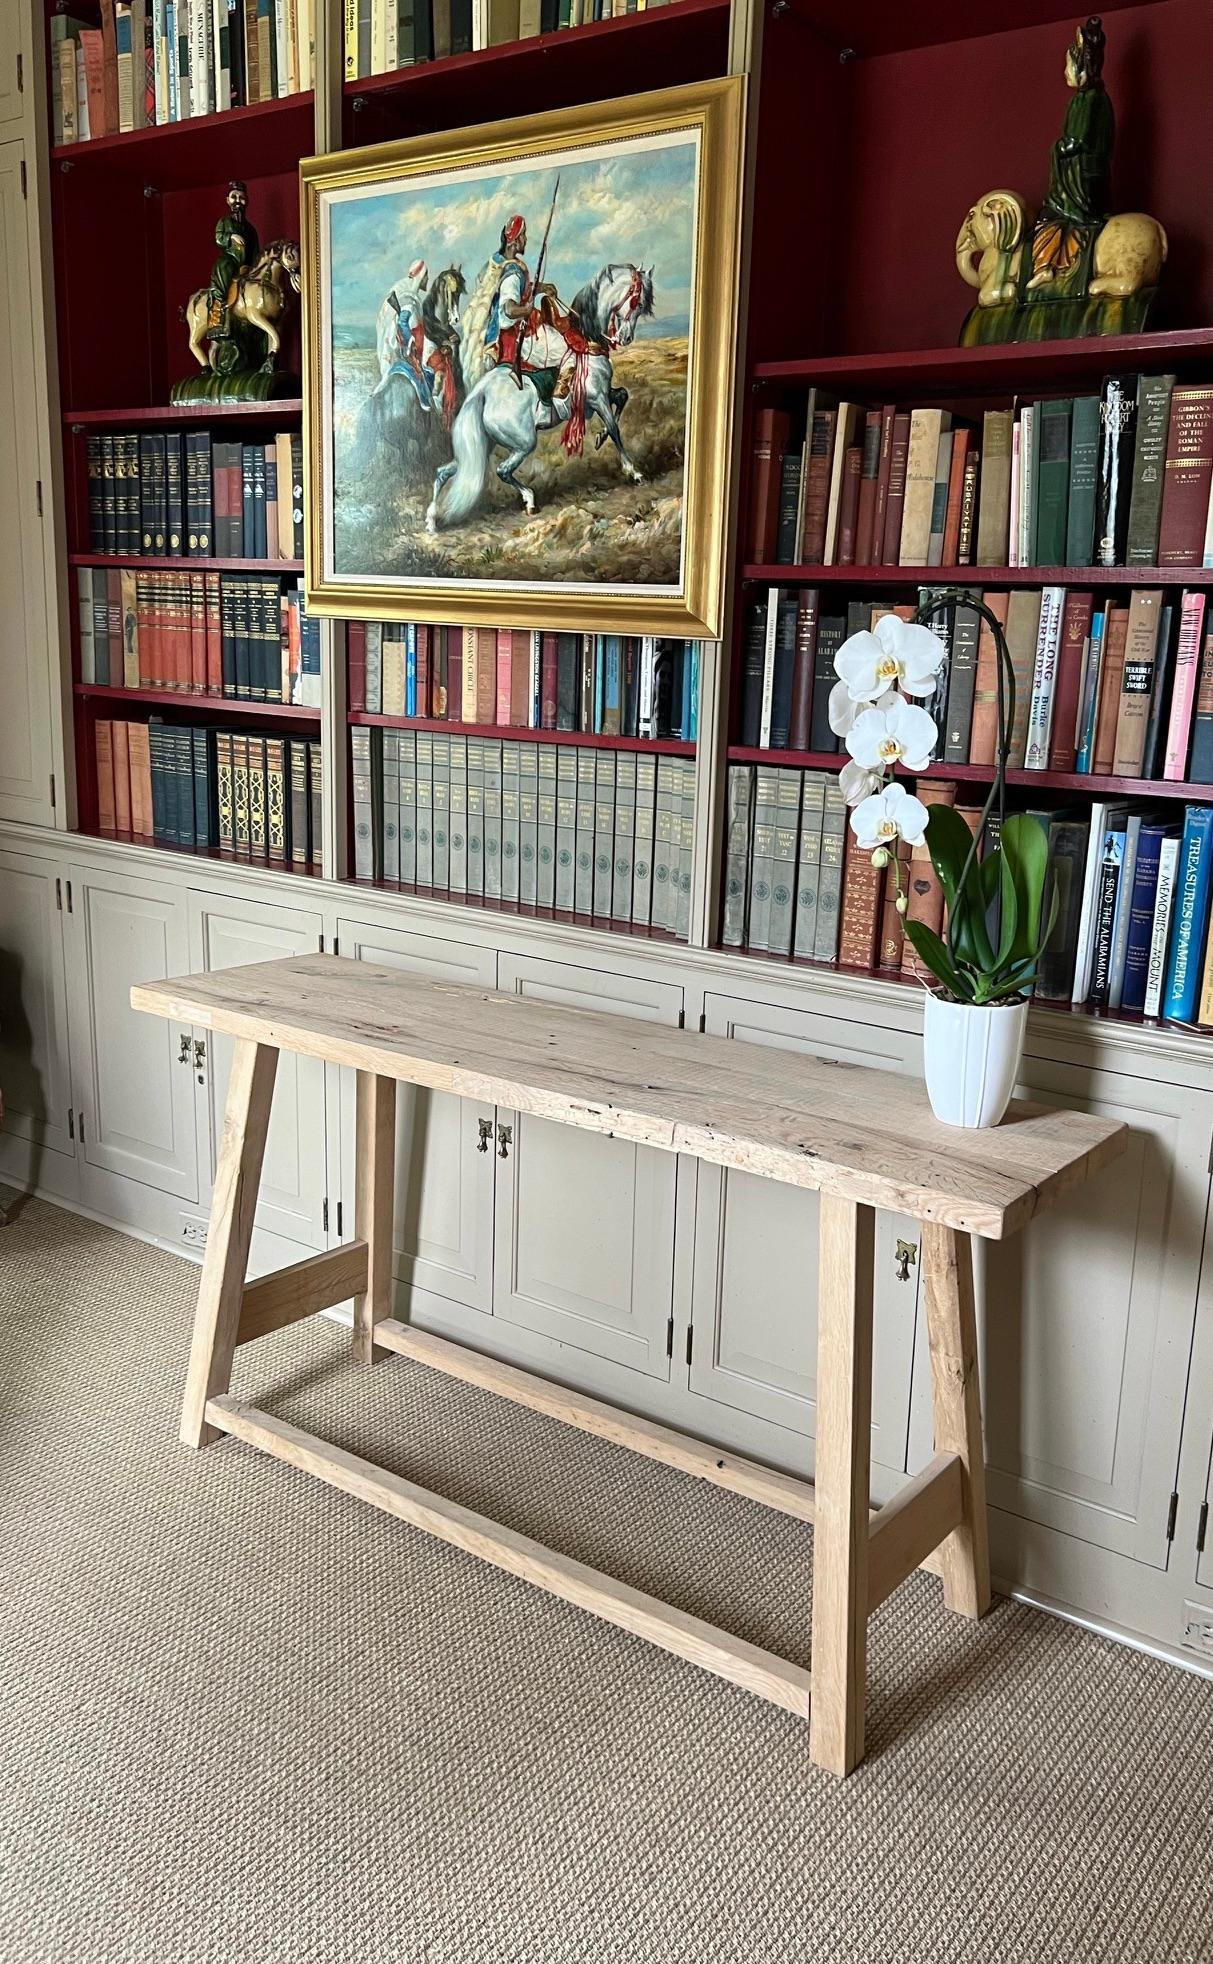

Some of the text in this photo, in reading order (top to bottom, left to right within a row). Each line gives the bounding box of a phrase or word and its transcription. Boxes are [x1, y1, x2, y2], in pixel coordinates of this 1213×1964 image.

[1181, 607, 1201, 626] NEW
[1034, 593, 1051, 689] SURRENDER
[1043, 603, 1062, 681] THE LONG
[1176, 628, 1199, 666] ORLEANS
[1125, 666, 1153, 674] TERRIBLE
[1126, 682, 1148, 690] SWORD
[1128, 674, 1147, 682] SWIFT
[1031, 695, 1041, 726] Davis
[1040, 695, 1050, 728] Burke
[1104, 877, 1116, 903] SEND
[1183, 837, 1202, 919] TREASURES
[1102, 905, 1113, 926] THE
[1153, 875, 1171, 933] MEMORIES
[1181, 919, 1192, 936] OF
[1094, 927, 1110, 989] ALABAMIANS
[1148, 948, 1162, 994] MOUNT
[1171, 937, 1189, 1001] AMERICA
